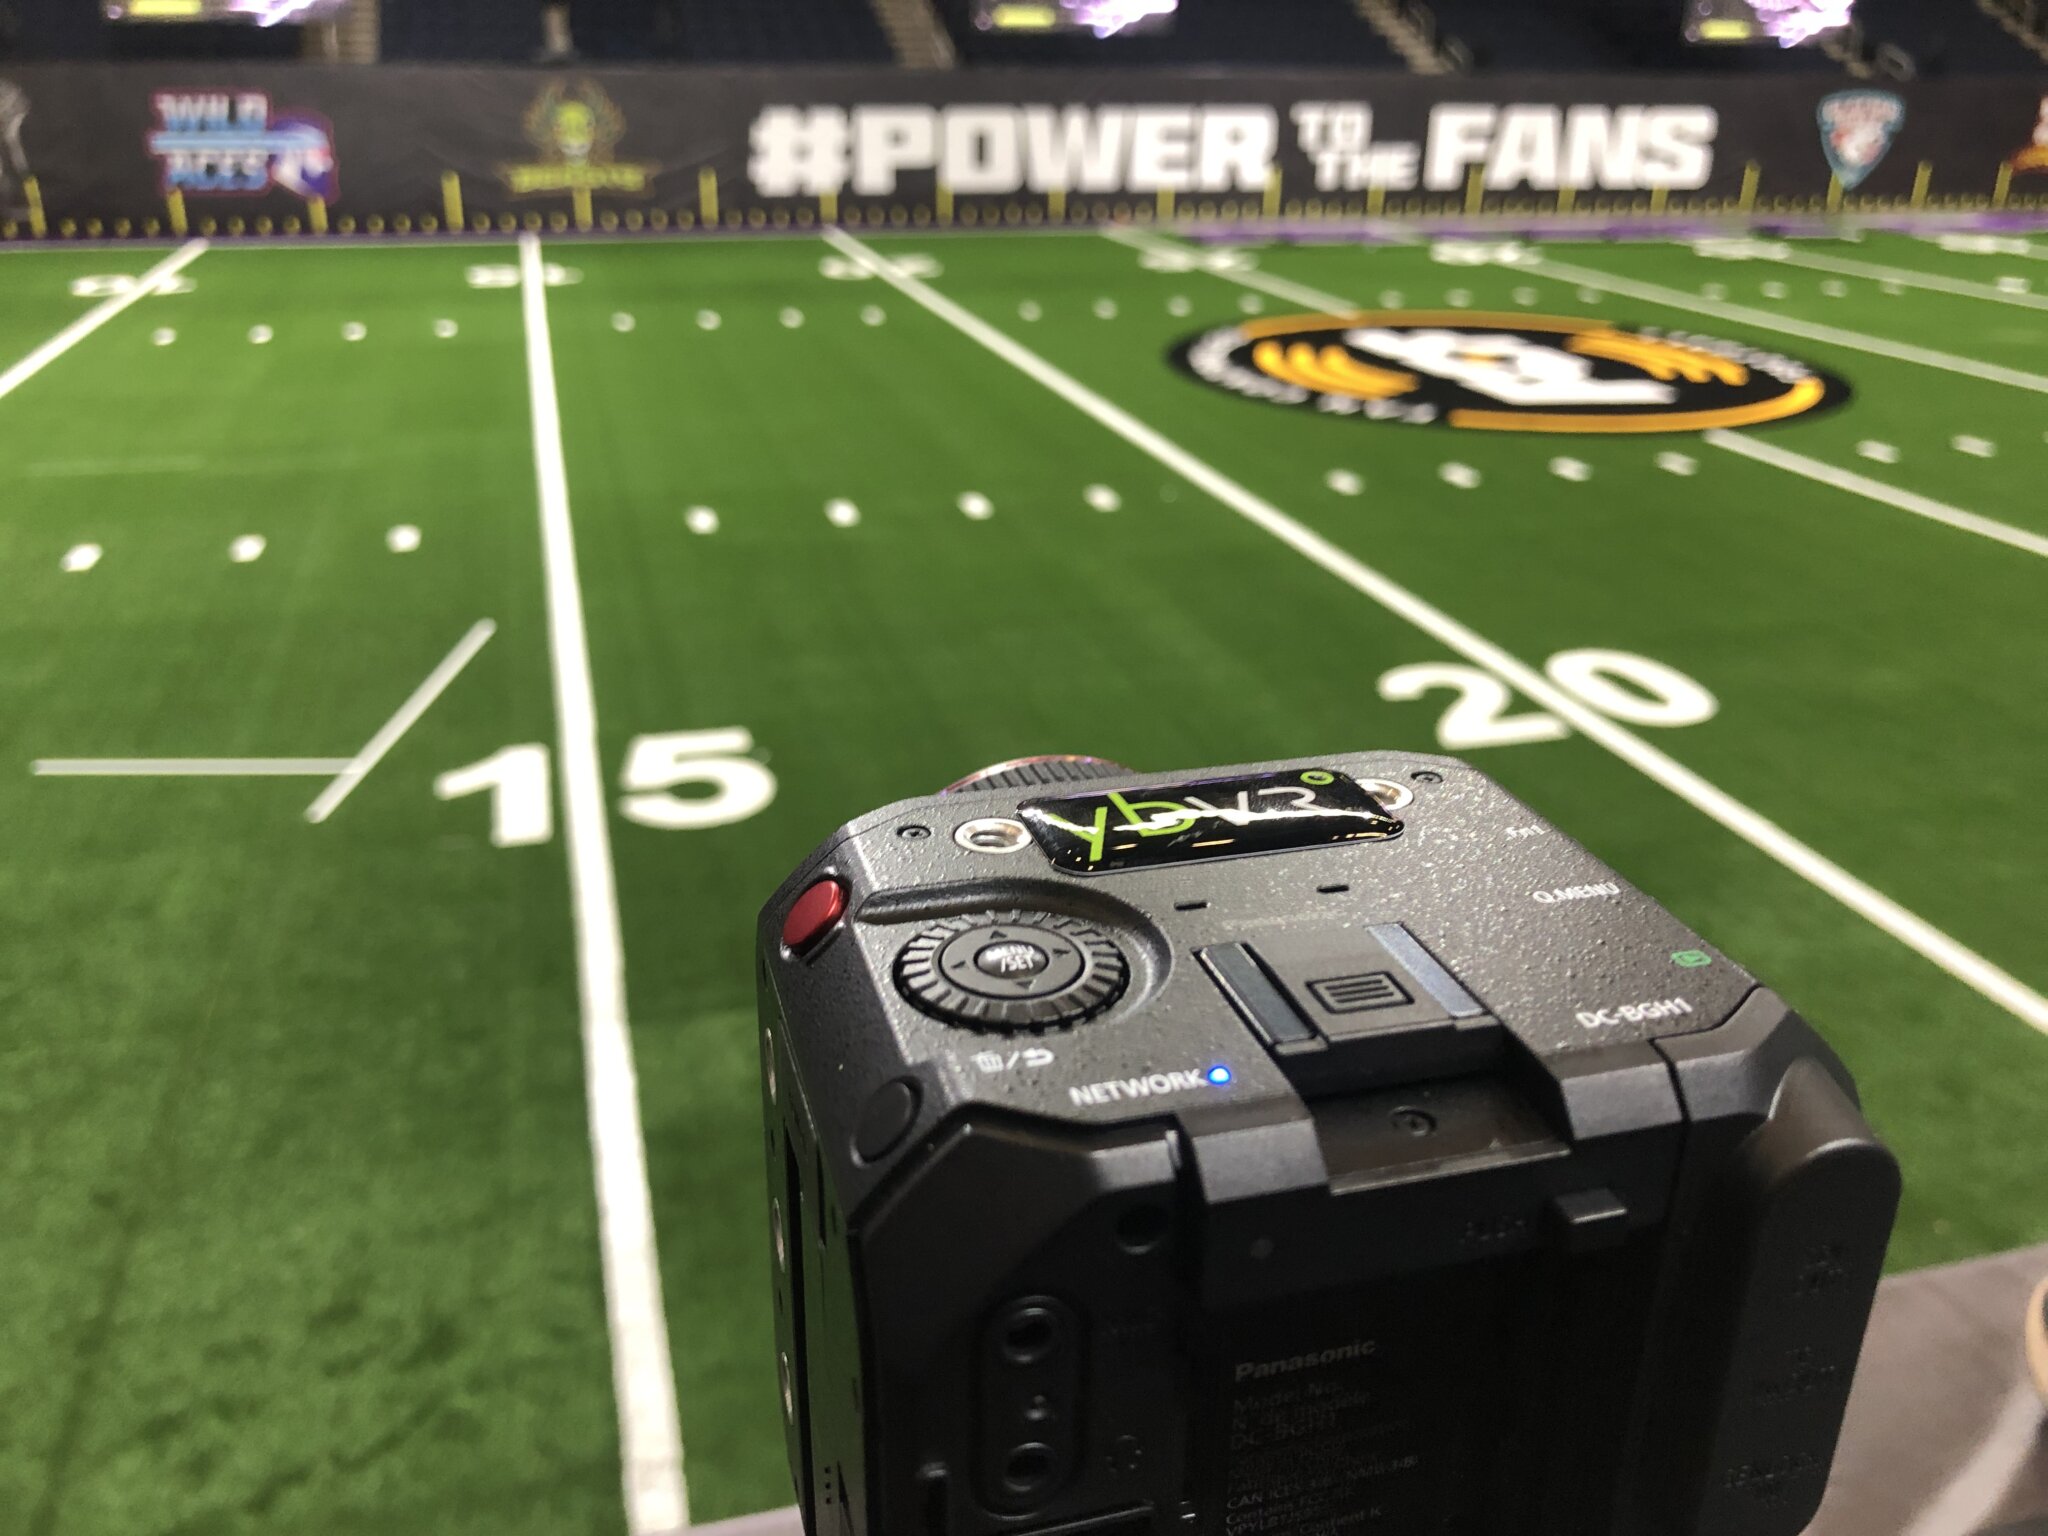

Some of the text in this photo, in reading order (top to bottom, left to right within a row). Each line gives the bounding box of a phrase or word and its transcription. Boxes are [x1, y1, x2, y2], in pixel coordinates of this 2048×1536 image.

[748, 101, 1718, 195] #POWER TO THE FANS
[1376, 648, 1719, 749] 20
[434, 726, 778, 848] 15
[1575, 997, 1693, 1029] DC-BGH1
[1068, 1067, 1208, 1106] NETWORK
[1235, 1340, 1376, 1382] Panasonic
